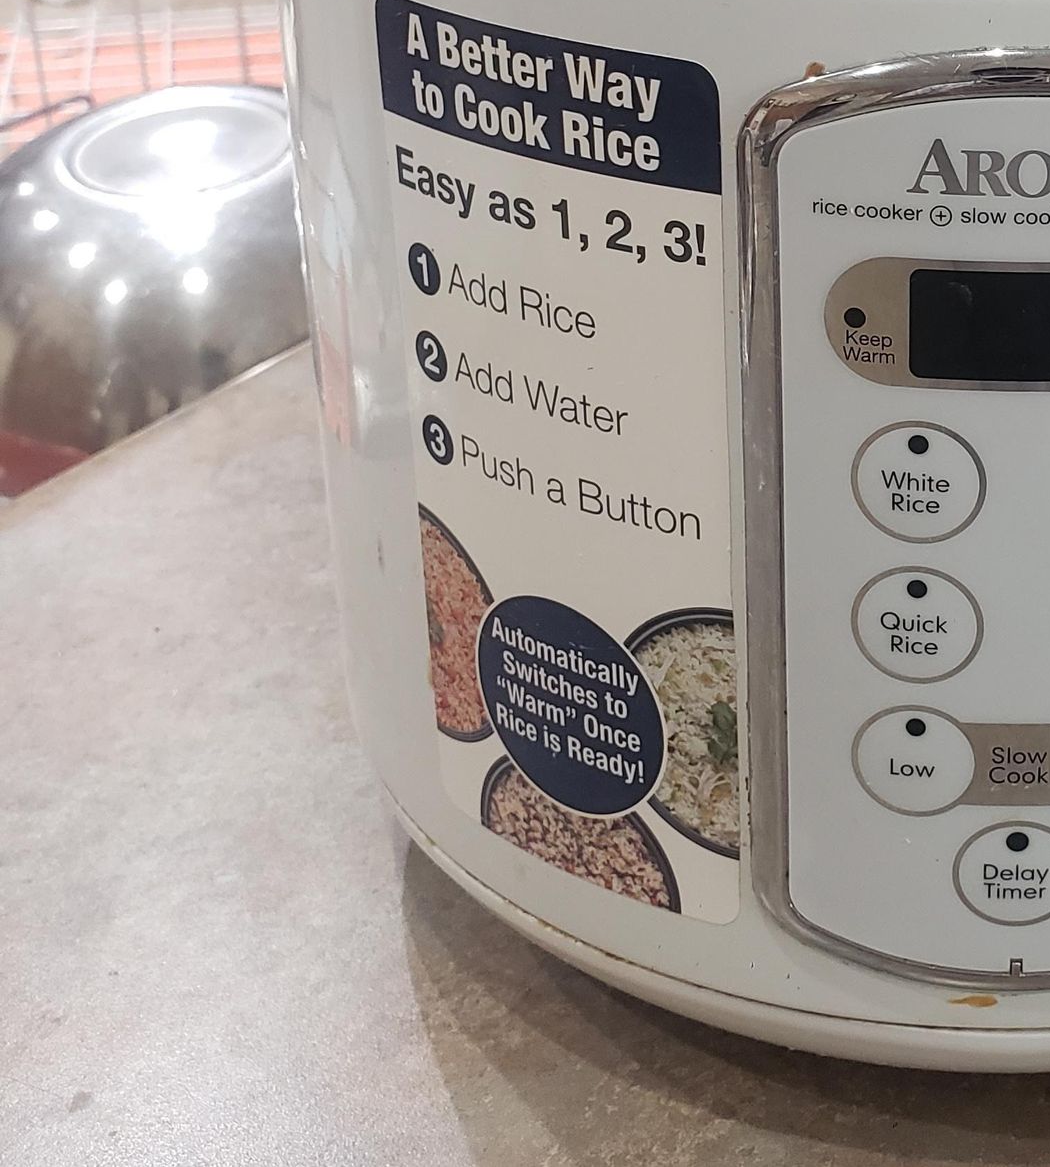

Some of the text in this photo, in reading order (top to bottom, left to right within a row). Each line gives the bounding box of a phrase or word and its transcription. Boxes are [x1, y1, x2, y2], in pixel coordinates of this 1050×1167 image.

[407, 13, 661, 123] A Better Way
[411, 69, 660, 172] to Cook Rice
[395, 145, 706, 267] Easy as 1, 2, 3!
[811, 198, 849, 217] rice
[854, 203, 923, 222] cooker
[960, 207, 1007, 225] slow
[448, 263, 508, 316] Add
[519, 286, 596, 338] Rice
[845, 330, 893, 349] Keep
[842, 346, 896, 365] Warm
[455, 352, 514, 405] Add
[523, 375, 628, 436] Water
[461, 435, 535, 496] Push
[546, 477, 567, 507] a
[578, 477, 701, 540] Button
[880, 469, 951, 494] White
[891, 493, 941, 514] Rice
[879, 610, 948, 634] Quick
[491, 616, 639, 697] Automatically
[890, 635, 939, 656] Rice
[503, 650, 629, 719] Switches to
[496, 702, 645, 784] Rice is Ready!
[583, 714, 642, 753] Once
[889, 758, 935, 778] Low
[991, 746, 1048, 765] Slow
[988, 766, 1049, 785] Cook
[983, 863, 1049, 884] Delay
[984, 883, 1047, 900] Timer
